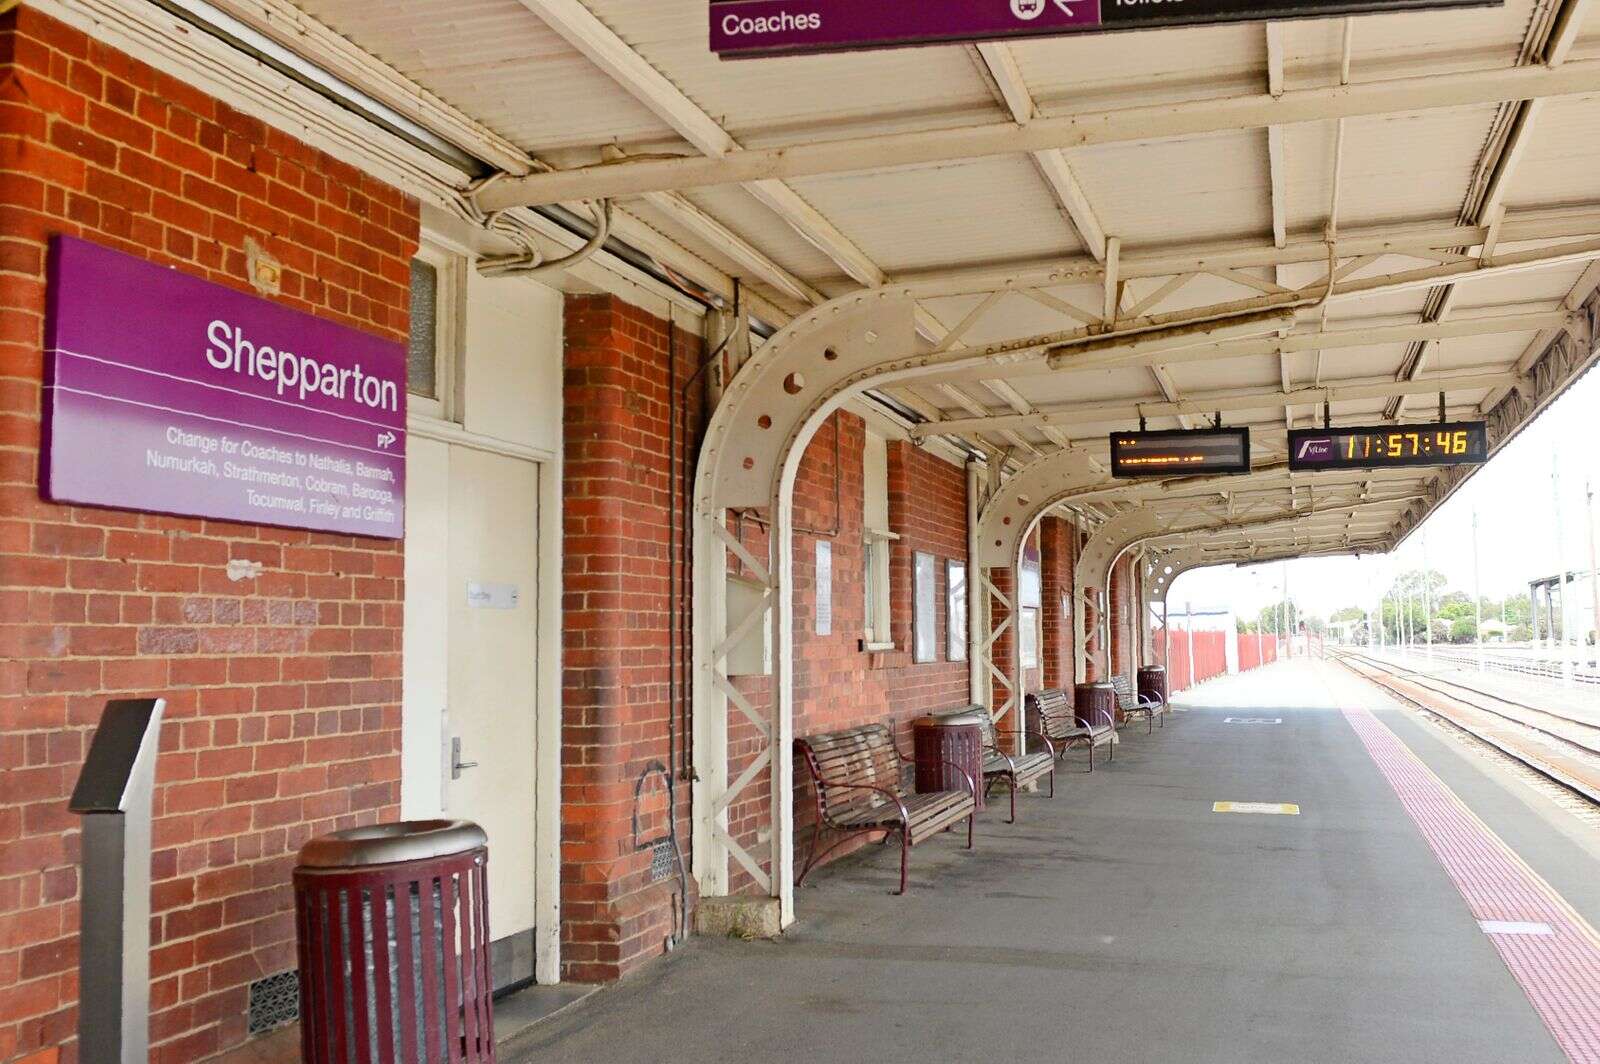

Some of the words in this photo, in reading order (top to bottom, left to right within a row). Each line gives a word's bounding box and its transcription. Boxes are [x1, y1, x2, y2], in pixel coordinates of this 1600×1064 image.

[722, 11, 821, 36] Coaches
[206, 320, 398, 411] Shepparton
[166, 426, 218, 454] Change
[221, 436, 239, 454] for
[241, 440, 293, 466] Coaches
[295, 452, 307, 466] to
[309, 453, 354, 477] Nathalia,
[356, 462, 396, 484] Barmah,
[1347, 431, 1467, 459] 11:57:46
[146, 449, 220, 478] Numurkah,
[223, 461, 303, 490] Strathmerton,
[305, 475, 350, 499] Cobram,
[246, 489, 306, 514] Tocumwal,
[309, 499, 340, 520] Finley
[342, 506, 361, 520] and
[363, 506, 395, 523] Griffith
